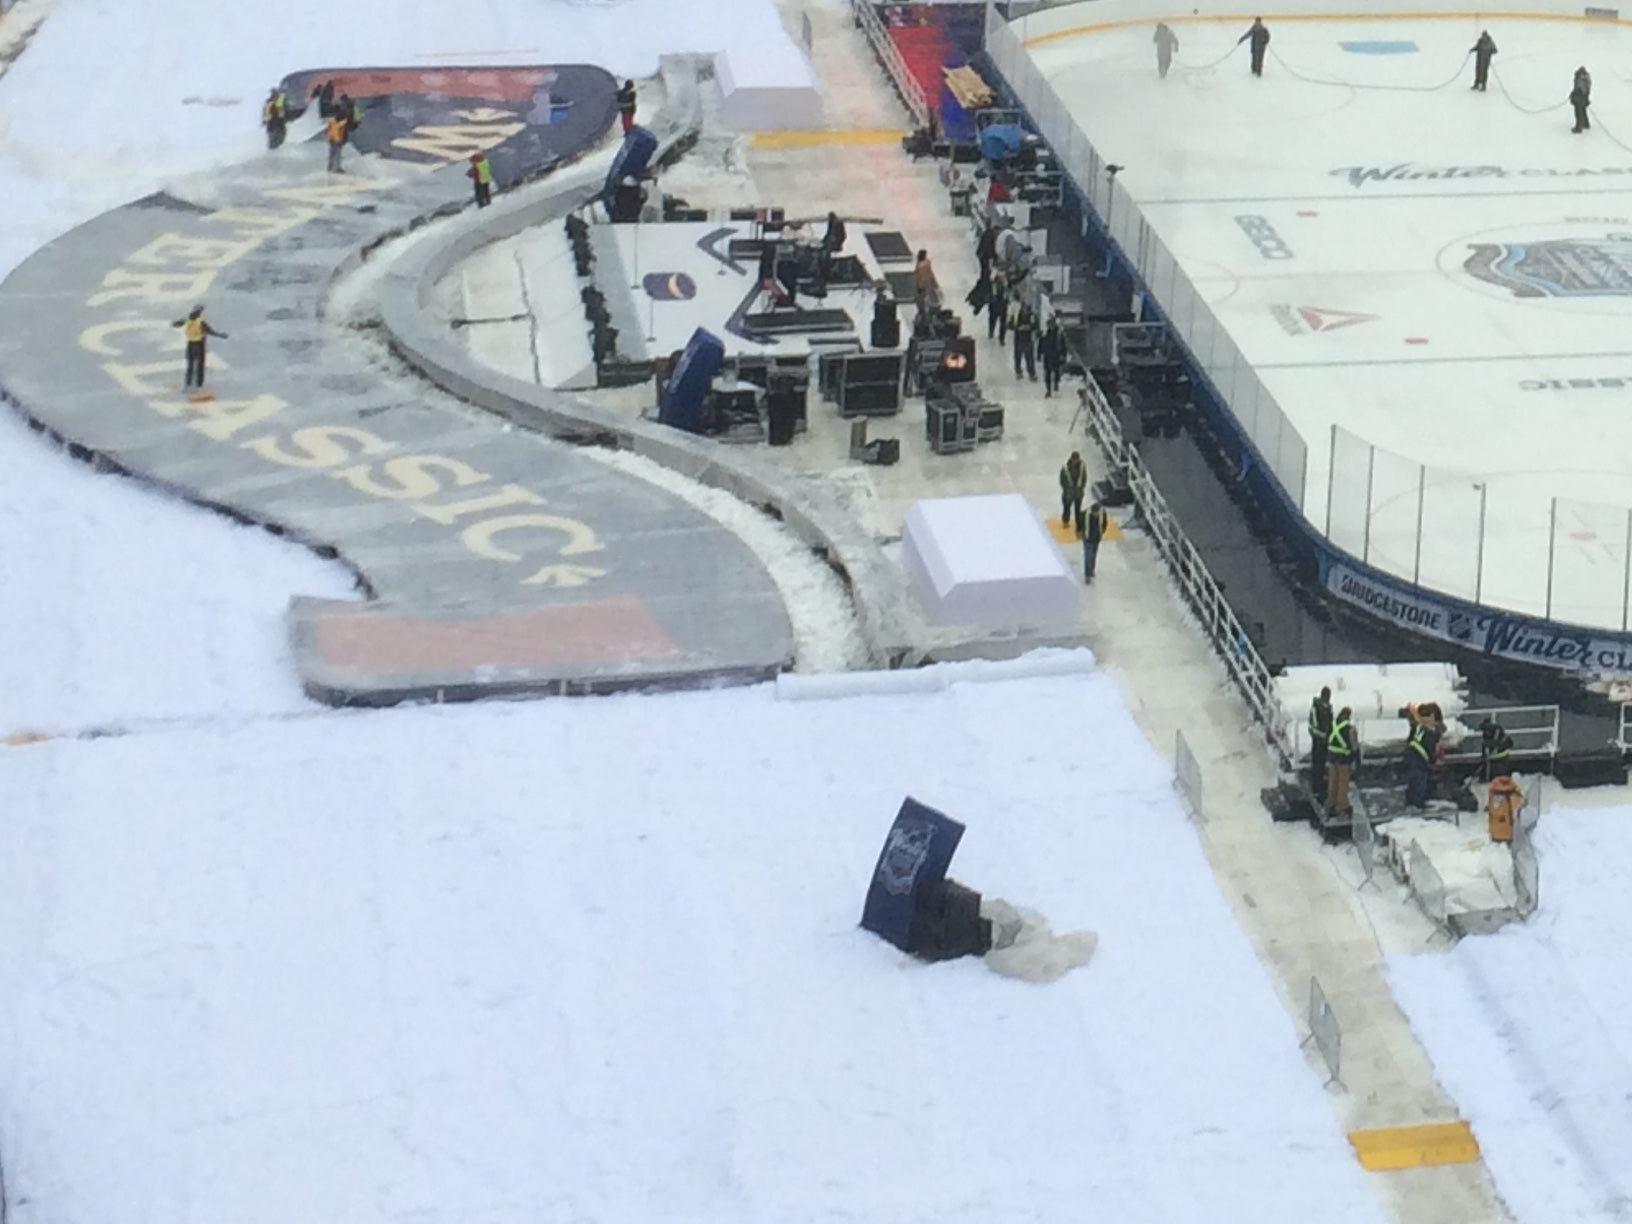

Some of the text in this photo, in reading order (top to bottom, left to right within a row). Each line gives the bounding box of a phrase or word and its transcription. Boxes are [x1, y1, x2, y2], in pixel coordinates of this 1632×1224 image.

[1328, 162, 1505, 189] Winter
[1234, 214, 1294, 260] GEICO
[1340, 574, 1443, 630] BRIDGESTONE
[1475, 614, 1593, 668] Winter
